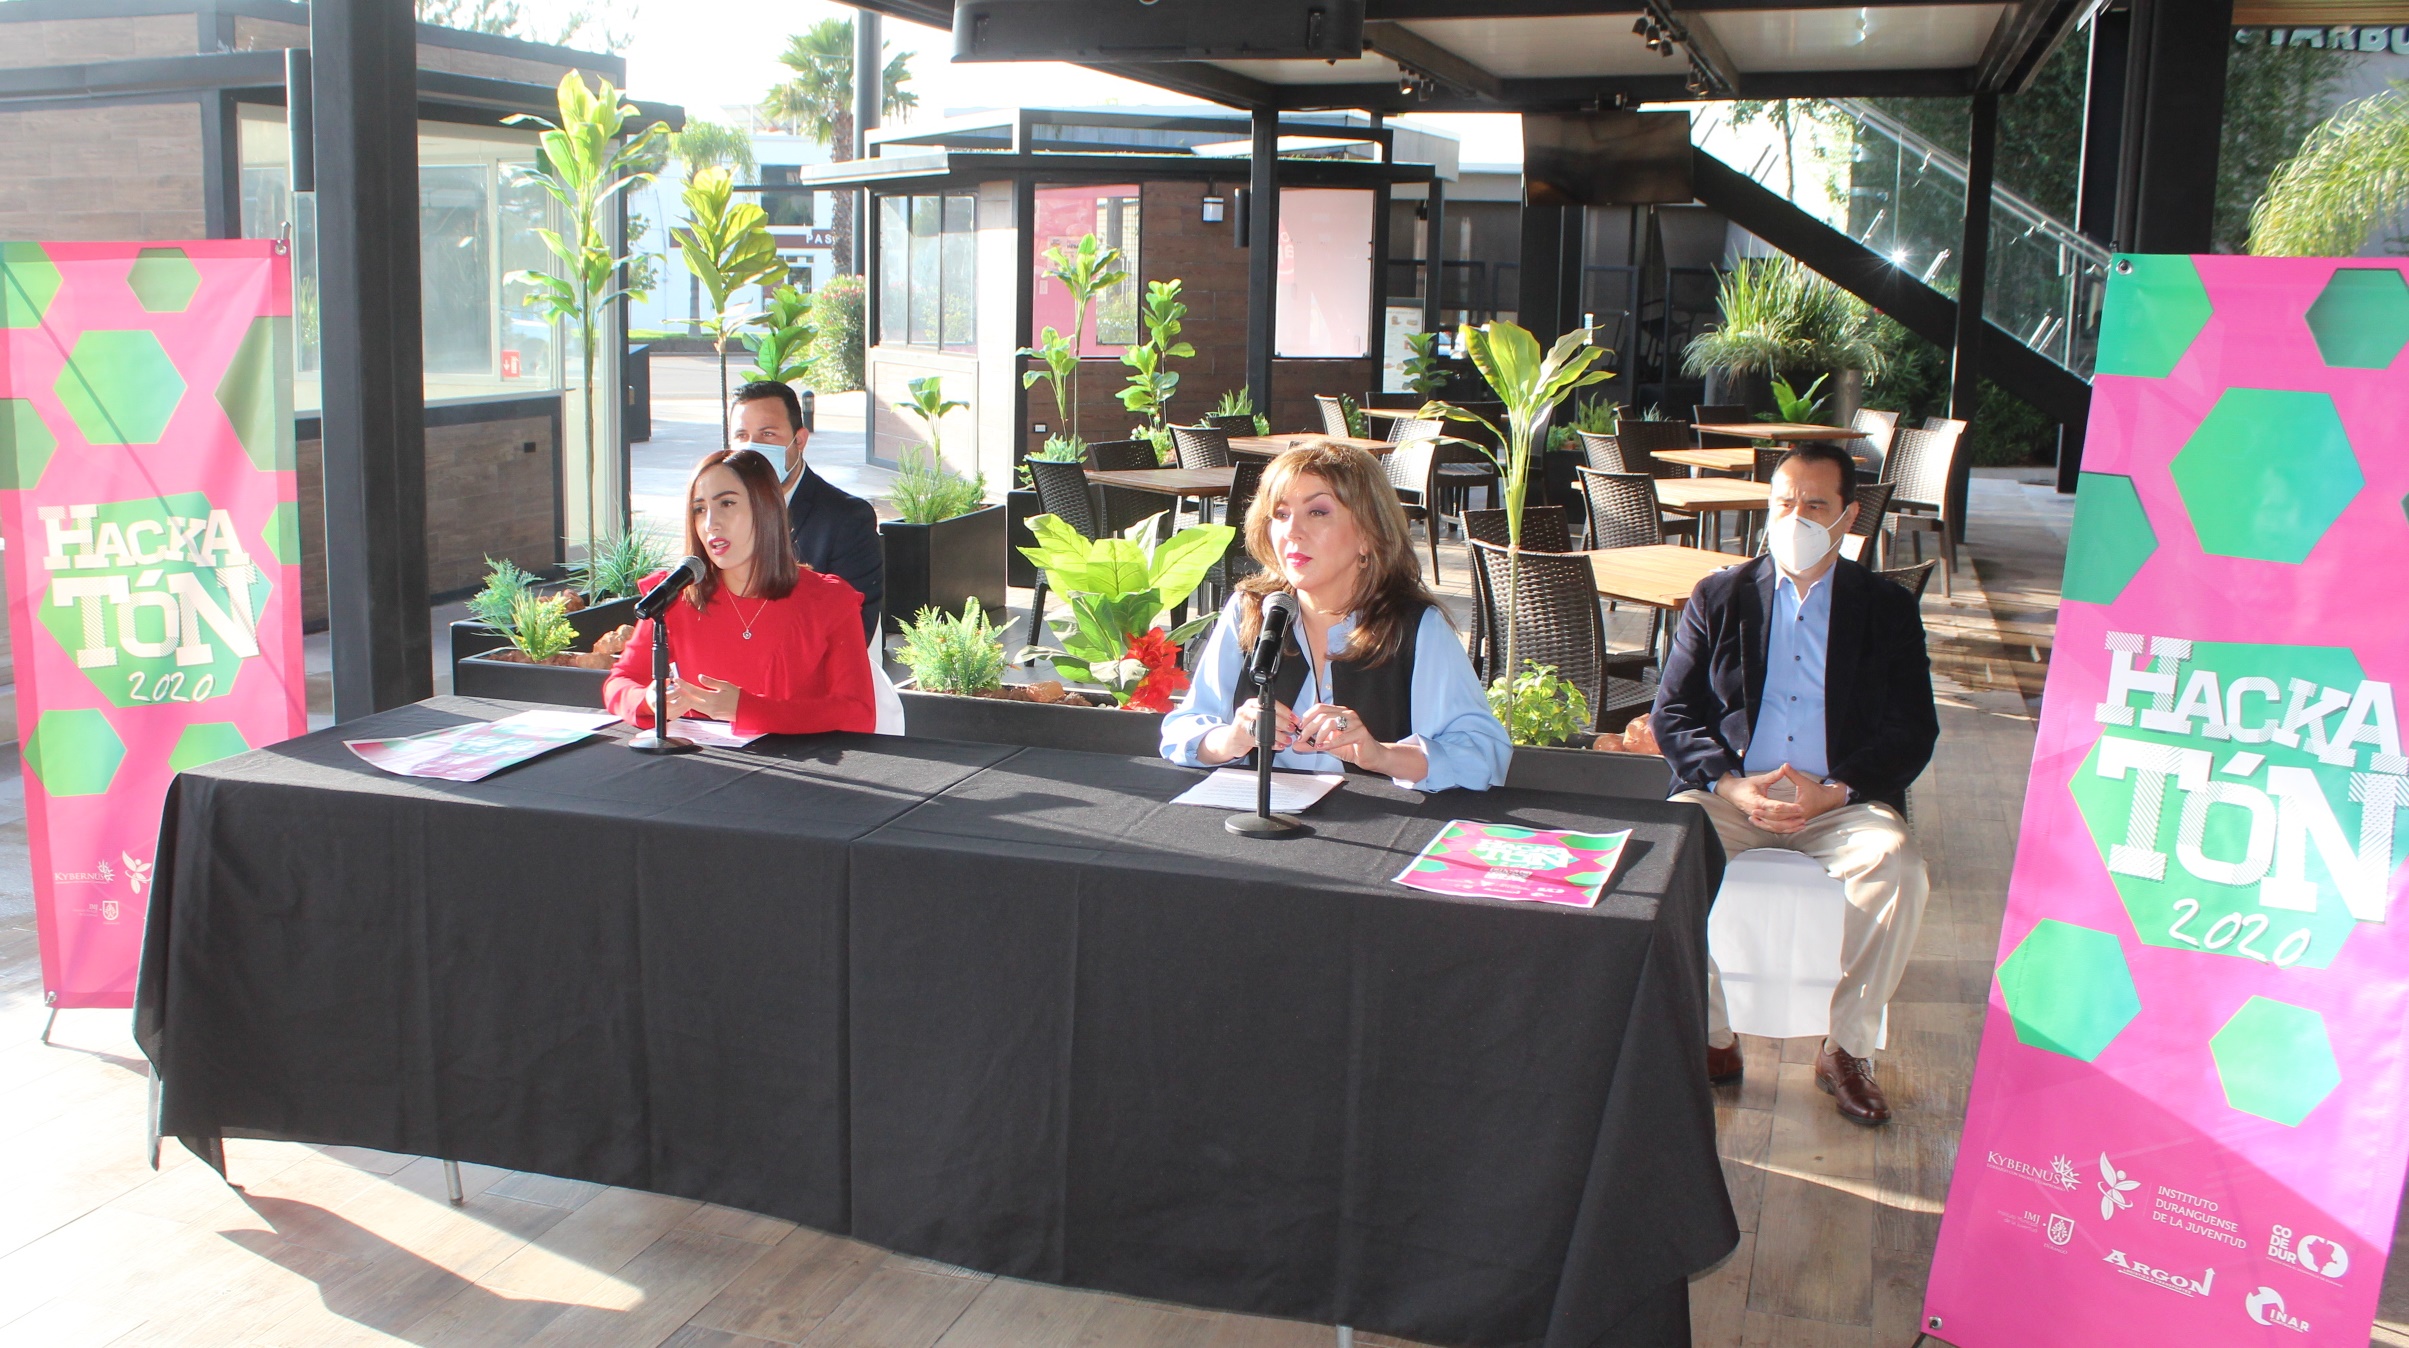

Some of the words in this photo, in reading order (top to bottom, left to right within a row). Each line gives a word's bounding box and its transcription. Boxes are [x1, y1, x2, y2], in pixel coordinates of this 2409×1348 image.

[37, 504, 250, 570] HACKA
[51, 564, 260, 669] TÓN
[128, 671, 214, 702] 2020
[2095, 630, 2409, 776] HACKA
[2096, 735, 2409, 923] TÓN
[54, 871, 105, 881] KYBERNUS
[2168, 898, 2311, 966] 2020
[1987, 1150, 2060, 1185] KYBERNUS
[2155, 1198, 2239, 1233] DURANGUENSE
[2157, 1185, 2219, 1212] INSTITUTO
[2023, 1210, 2040, 1225] IMJ
[2152, 1211, 2168, 1223] DE
[2169, 1216, 2183, 1228] LA
[2185, 1222, 2247, 1249] JUVENTUD
[2272, 1224, 2292, 1239] CO
[2267, 1245, 2297, 1265] DUR
[2269, 1234, 2290, 1250] DE
[2102, 1249, 2215, 1296] ARGON
